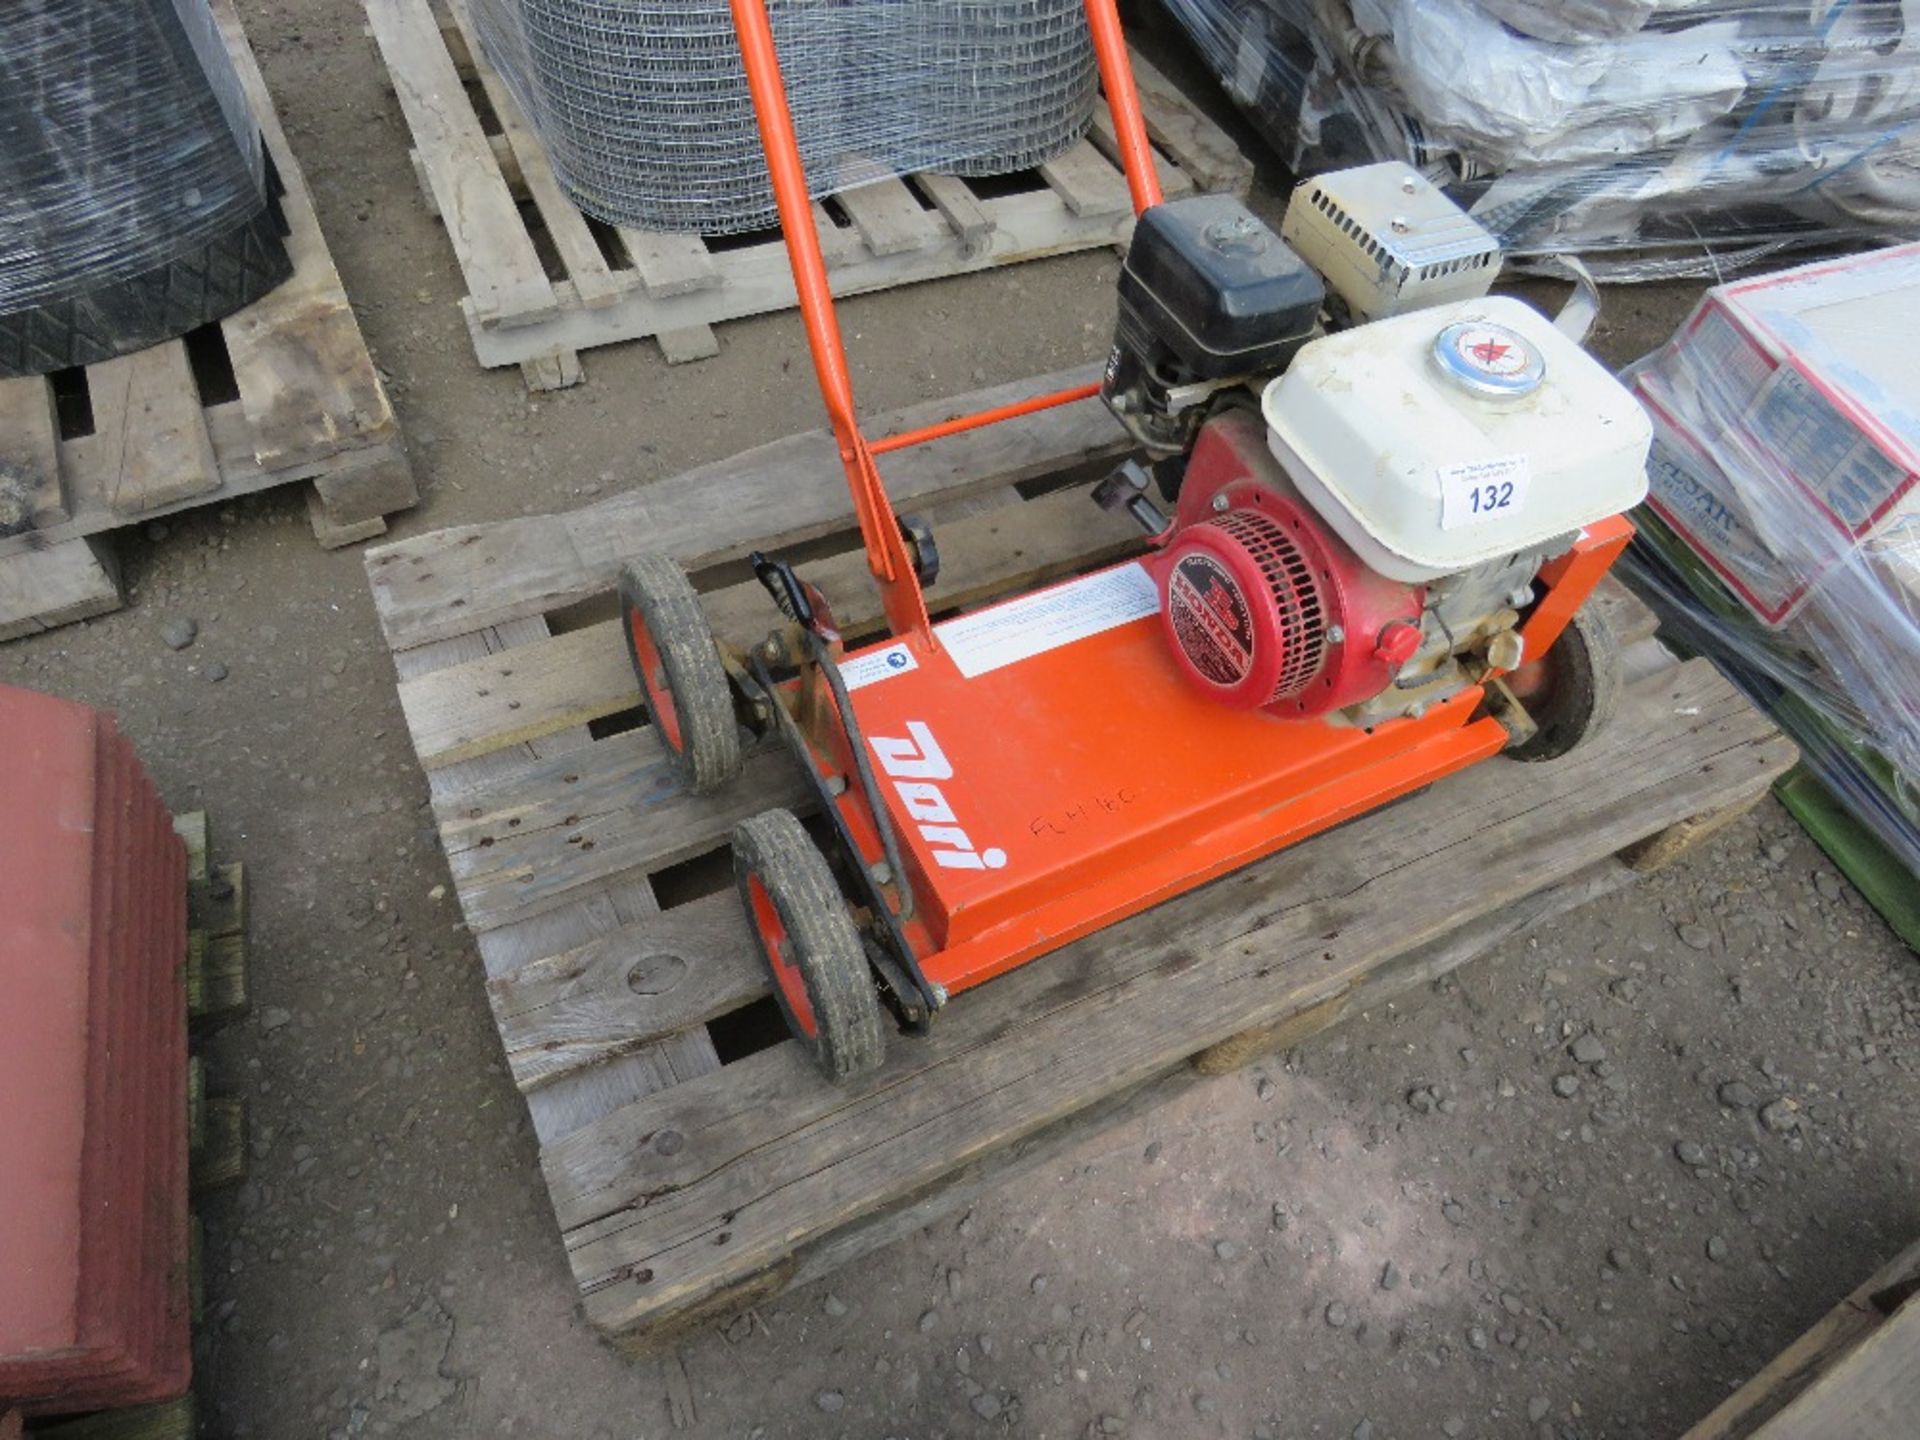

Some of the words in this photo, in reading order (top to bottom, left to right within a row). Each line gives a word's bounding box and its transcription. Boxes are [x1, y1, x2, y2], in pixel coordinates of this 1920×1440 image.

[1469, 481, 1514, 513] 132
[1173, 571, 1248, 672] HONDA
[868, 721, 1007, 869] Dori
